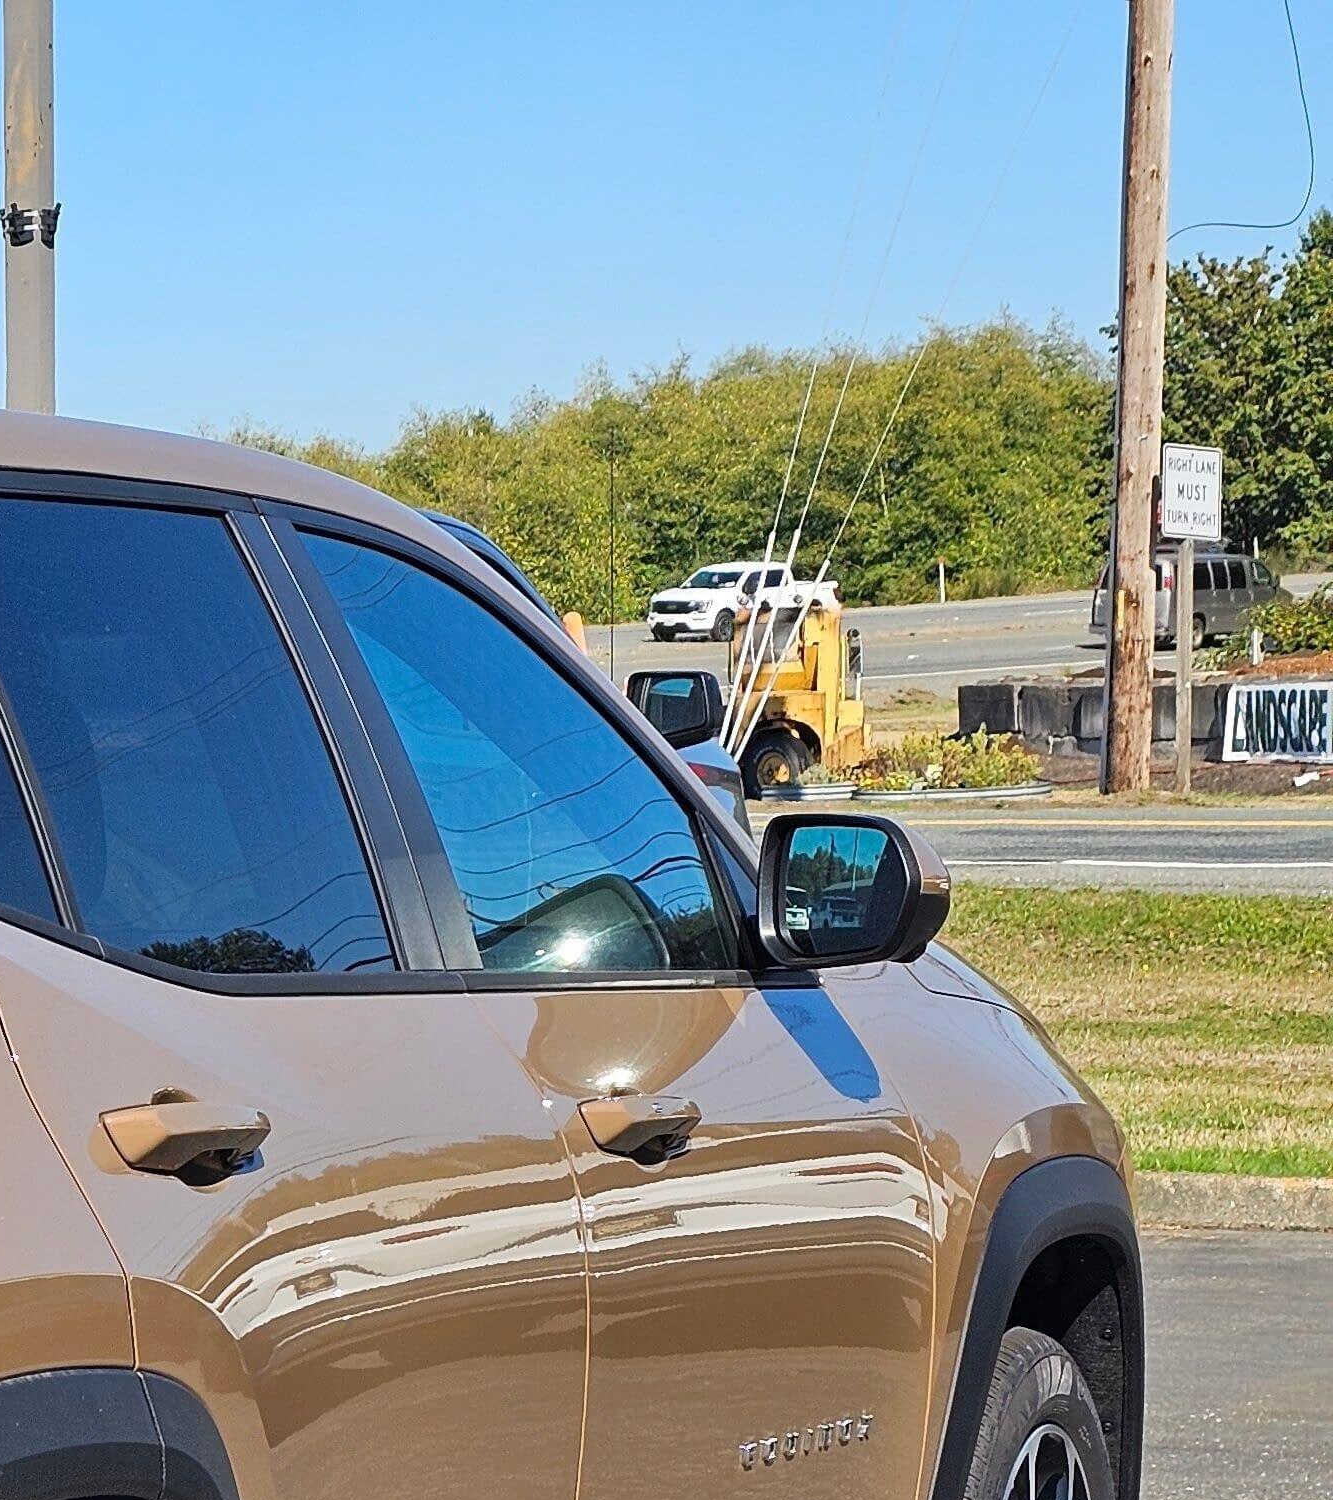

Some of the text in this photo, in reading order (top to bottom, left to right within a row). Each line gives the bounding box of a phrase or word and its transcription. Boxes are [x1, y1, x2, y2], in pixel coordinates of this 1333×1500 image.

[1168, 457, 1216, 475] RIGHT LANE
[1177, 483, 1207, 502] MUST
[1167, 509, 1216, 527] TURN RIGHT
[1232, 688, 1328, 752] LANDSCAPE
